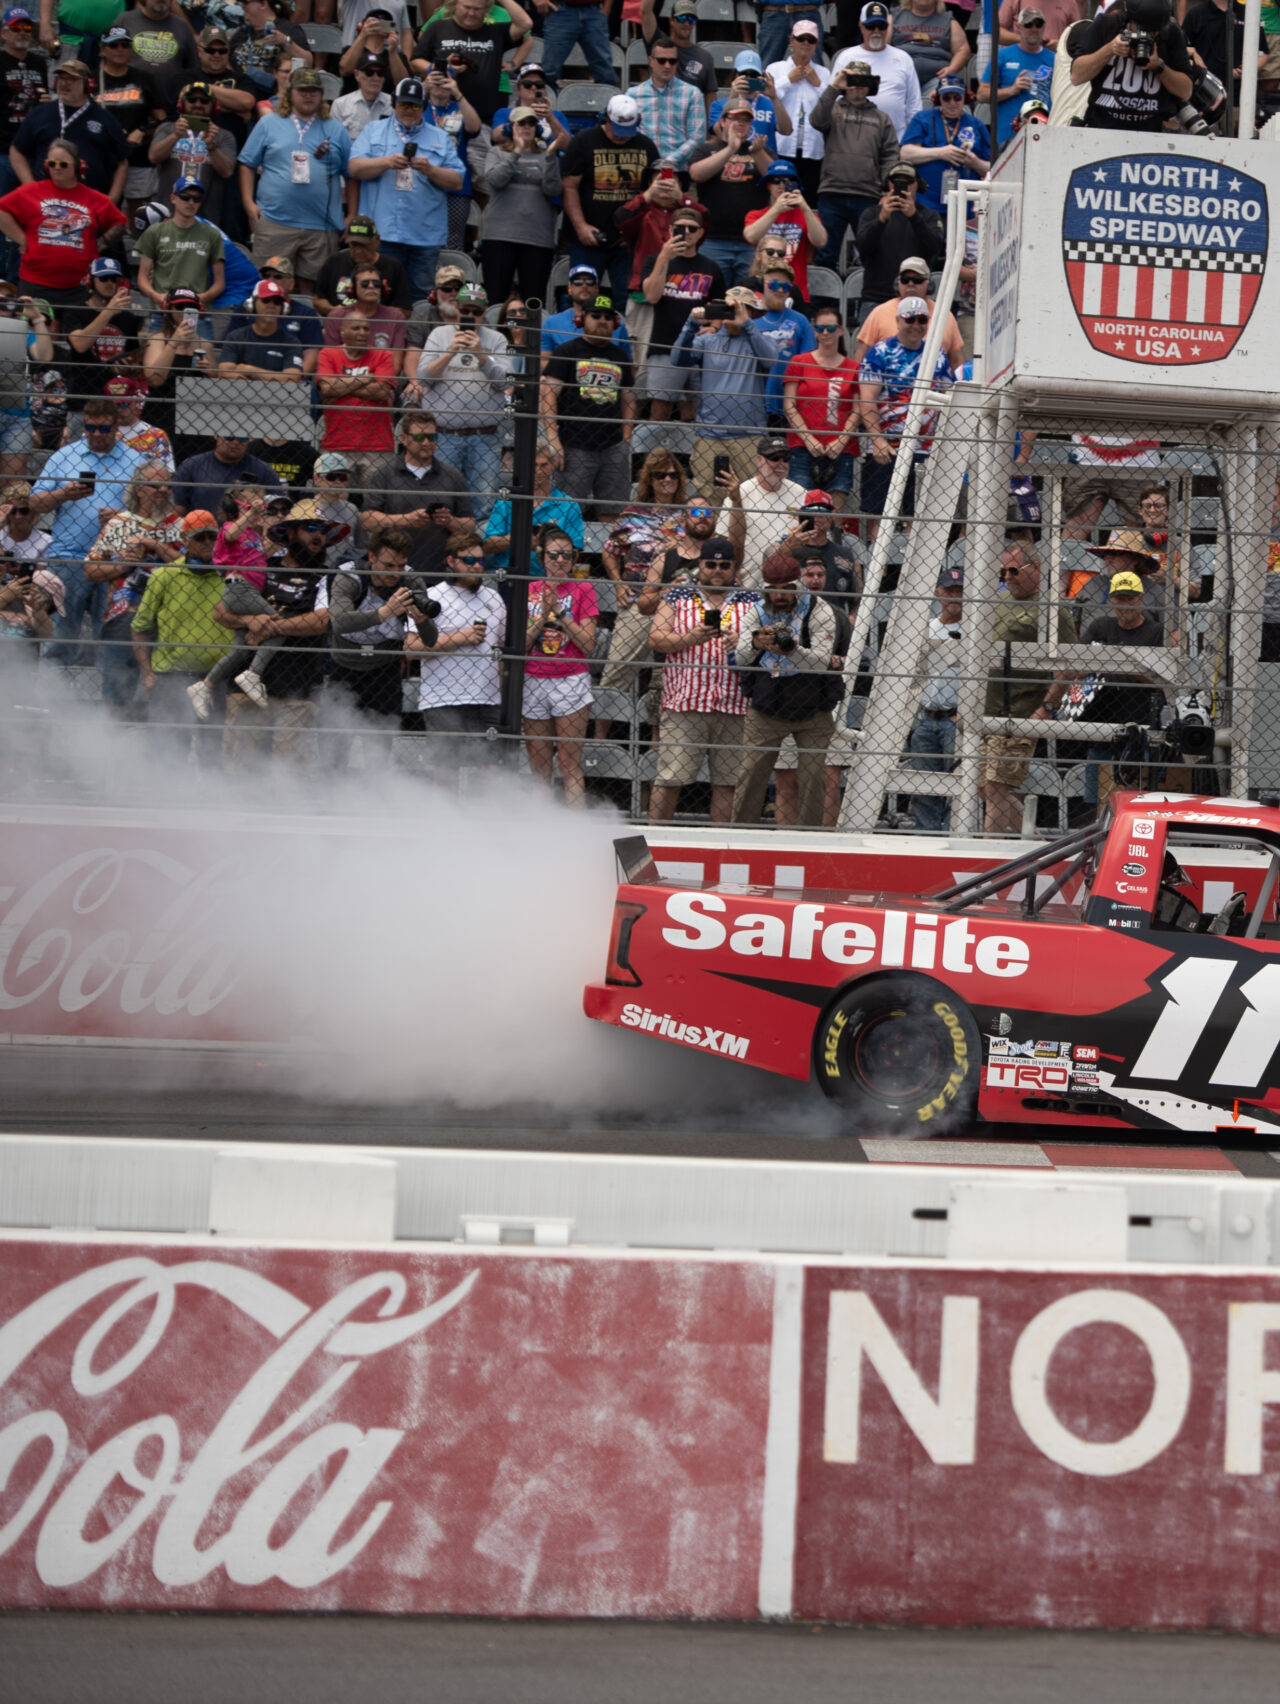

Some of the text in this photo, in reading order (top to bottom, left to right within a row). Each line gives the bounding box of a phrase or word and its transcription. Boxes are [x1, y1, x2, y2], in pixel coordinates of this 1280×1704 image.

[138, 40, 175, 50] BLANEY
[1095, 93, 1159, 111] NASCAR
[593, 154, 648, 166] OLD MAN
[1120, 162, 1219, 190] NORTH
[1074, 187, 1262, 222] WILKESBORO
[1089, 216, 1245, 248] SPEEDWAY
[1093, 322, 1225, 342] NORTH CAROLINA
[1135, 339, 1182, 359] USA
[1237, 349, 1248, 357] TM
[589, 373, 612, 386] 12
[1128, 844, 1149, 858] JBL
[1108, 919, 1131, 928] Mobil
[661, 892, 1030, 978] Safelite
[620, 1003, 750, 1059] SiriusXM
[825, 1009, 849, 1078] EAGLE
[991, 1039, 1007, 1048] WIX
[1075, 1048, 1096, 1059] SEM
[1031, 1059, 1068, 1067] DEVELOPMENT
[989, 1062, 1068, 1088] TRD
